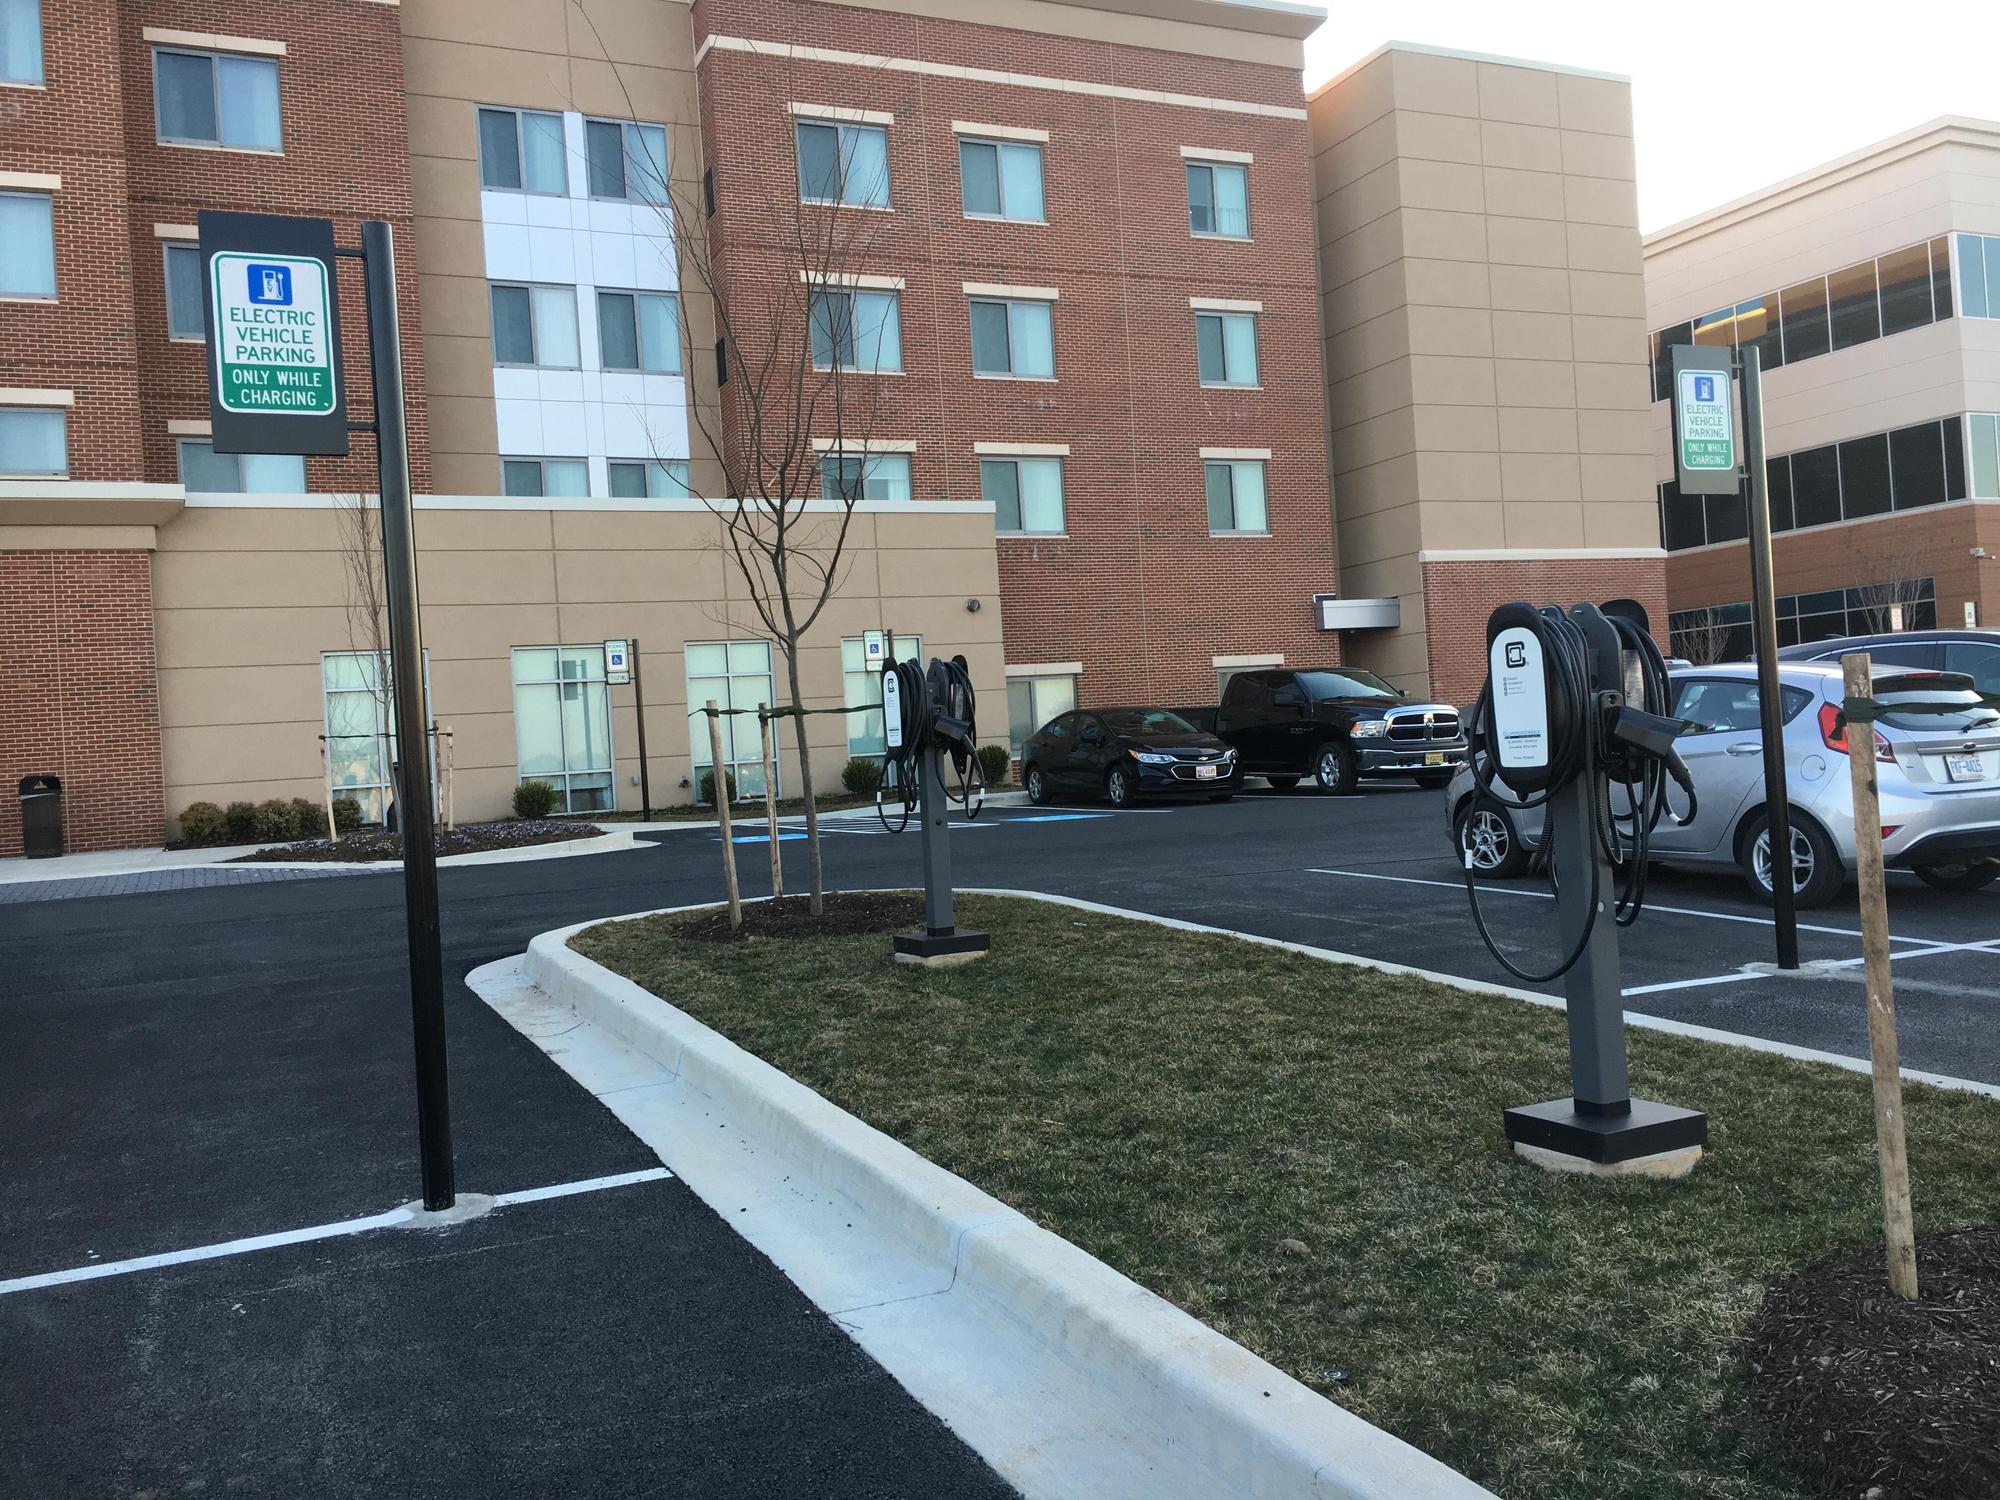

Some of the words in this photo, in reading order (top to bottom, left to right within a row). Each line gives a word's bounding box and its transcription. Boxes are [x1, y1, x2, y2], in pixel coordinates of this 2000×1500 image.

[229, 306, 316, 327] ELECTRIC
[236, 326, 313, 345] VEHICLE
[235, 345, 316, 364] PARKING
[232, 368, 270, 386] ONLY
[277, 371, 322, 388] WHILE
[240, 388, 317, 407] CHARGING
[1687, 404, 1724, 415] ELECTRIC
[1689, 415, 1723, 427] VEHICLE
[1689, 427, 1725, 439] PARKING
[1688, 442, 1705, 453] ONLY
[1707, 443, 1727, 453] WHILE
[1691, 454, 1725, 465] CHARGING
